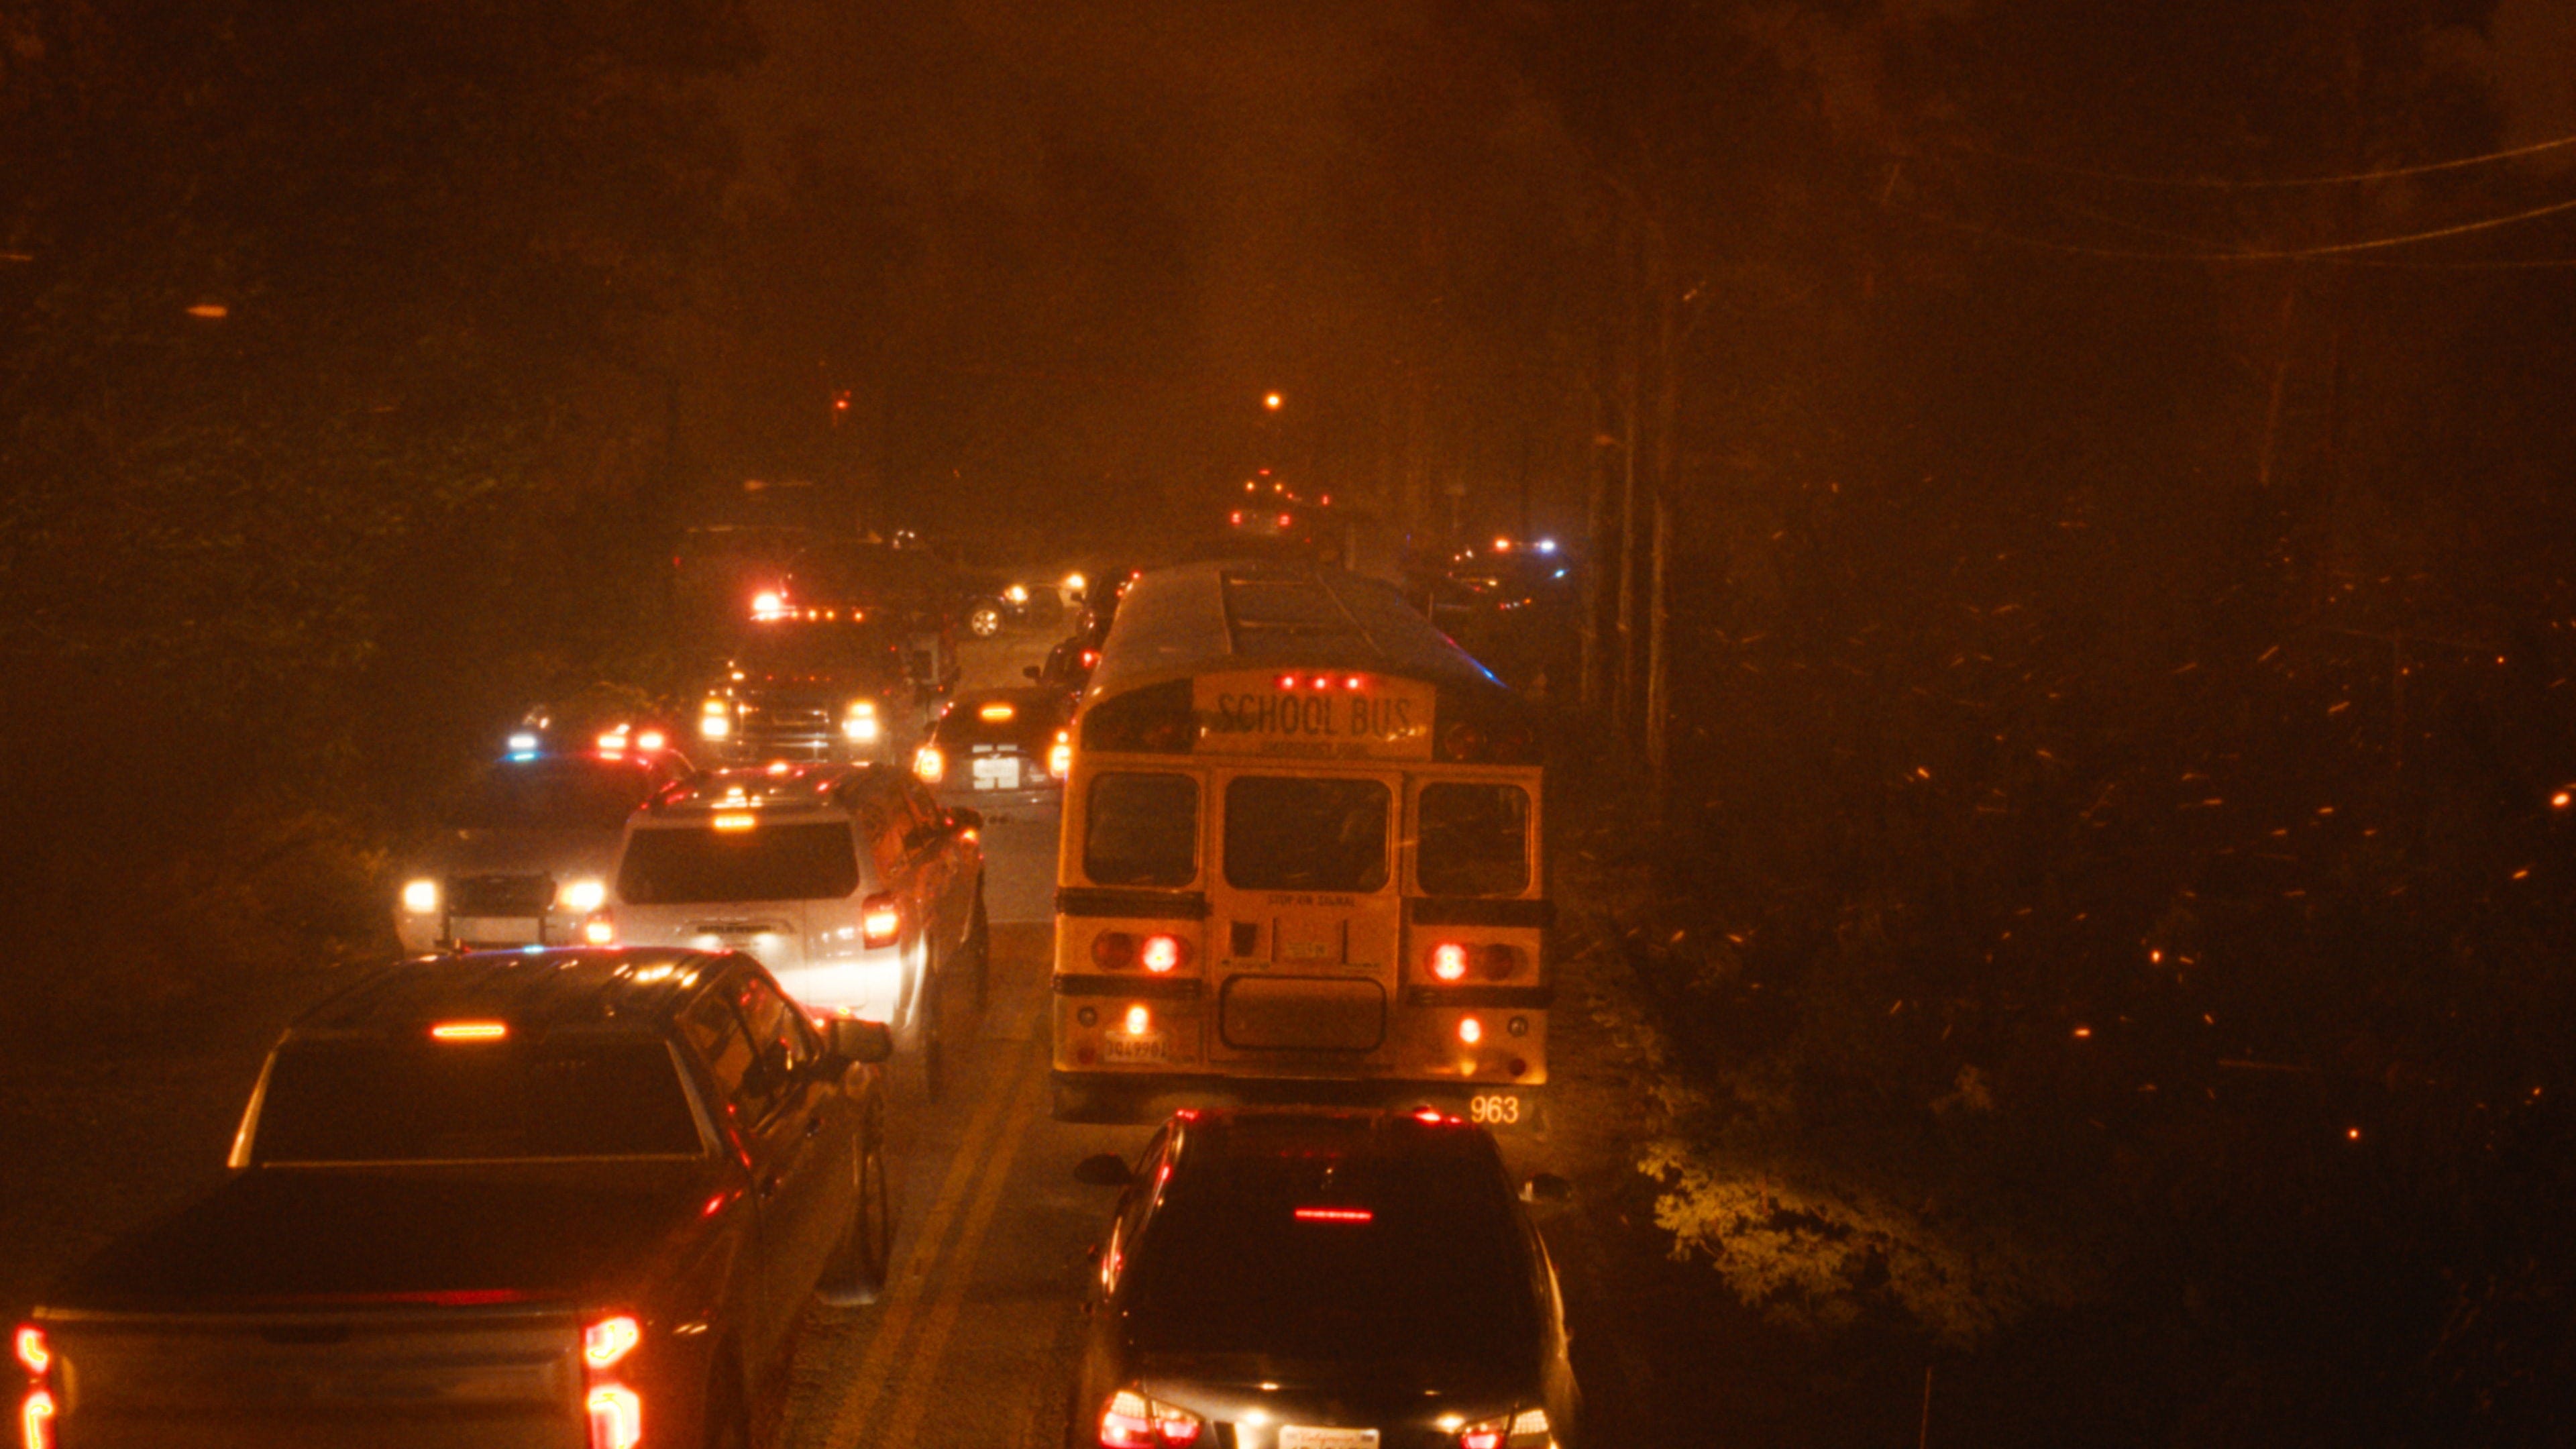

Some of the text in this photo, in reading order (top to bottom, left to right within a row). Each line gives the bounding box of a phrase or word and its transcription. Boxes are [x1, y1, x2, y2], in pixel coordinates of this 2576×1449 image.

[1218, 692, 1411, 738] SCHOOL BUS
[1470, 1095, 1519, 1124] 963
